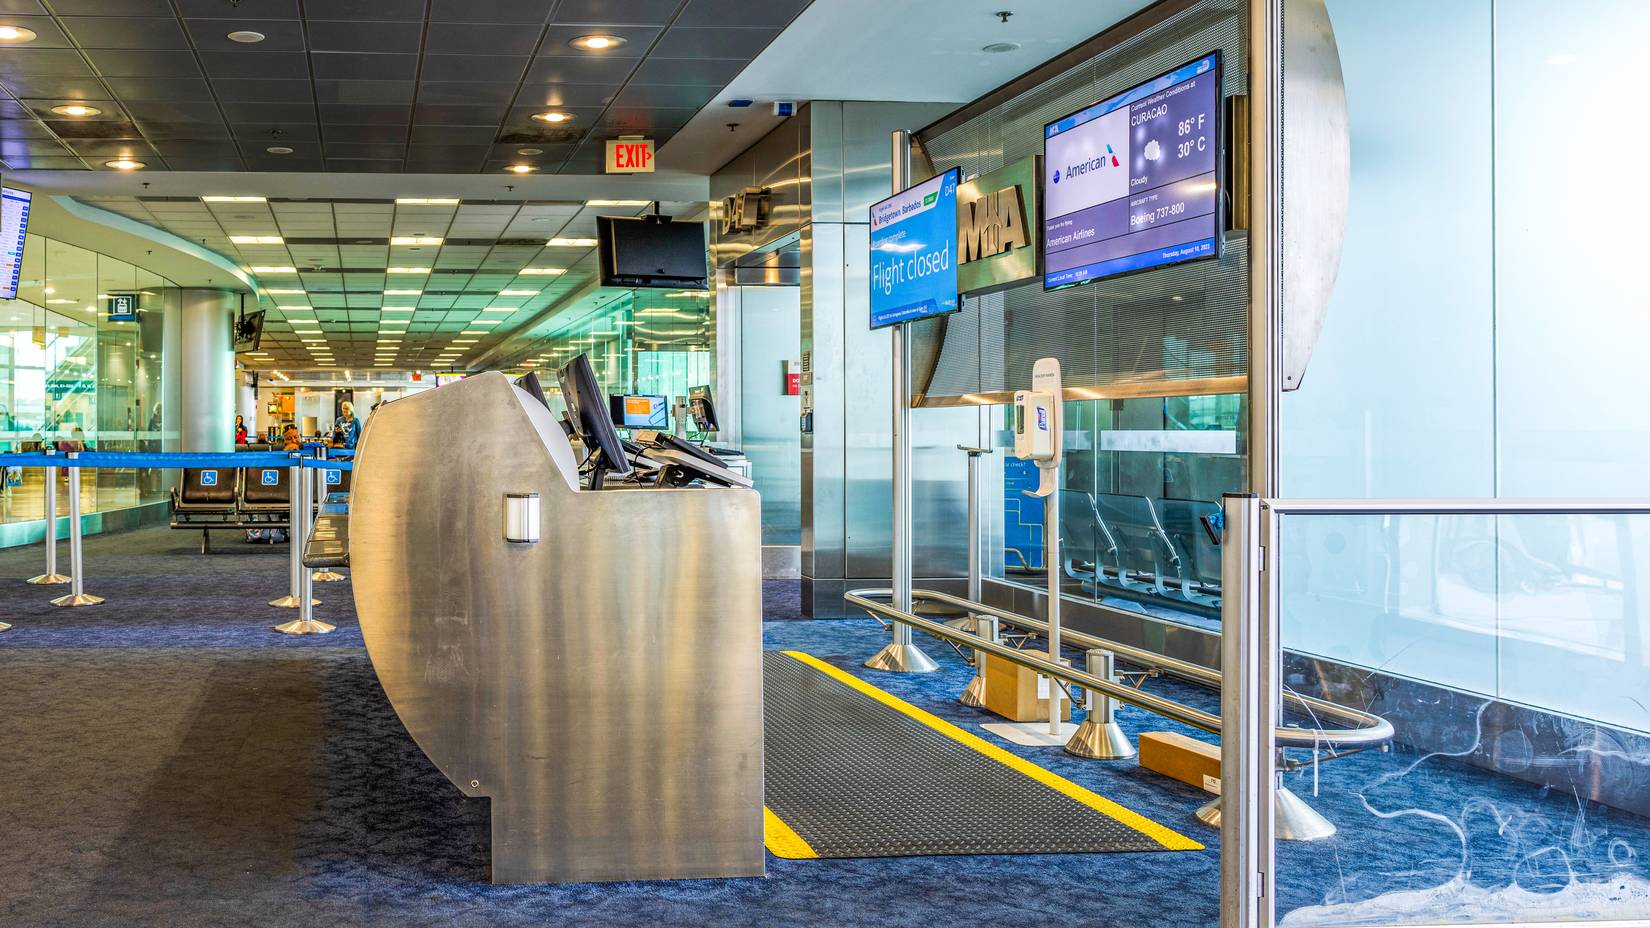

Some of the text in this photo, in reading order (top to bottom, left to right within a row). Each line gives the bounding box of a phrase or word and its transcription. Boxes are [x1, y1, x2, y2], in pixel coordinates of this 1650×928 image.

[1131, 101, 1147, 112] Current
[1147, 93, 1165, 104] Weather
[1166, 84, 1190, 98] Conditions
[1131, 104, 1168, 126] CURACAO
[1198, 114, 1205, 130] F
[1198, 136, 1206, 152] C
[616, 144, 648, 168] EXIT
[1066, 155, 1106, 180] American
[1131, 175, 1148, 187] Cloudy
[902, 199, 922, 214] Barbados
[1131, 202, 1185, 226] Boeing 737-800
[1046, 228, 1095, 248] American Airlines
[1180, 247, 1194, 255] August
[873, 240, 949, 296] Flight closed
